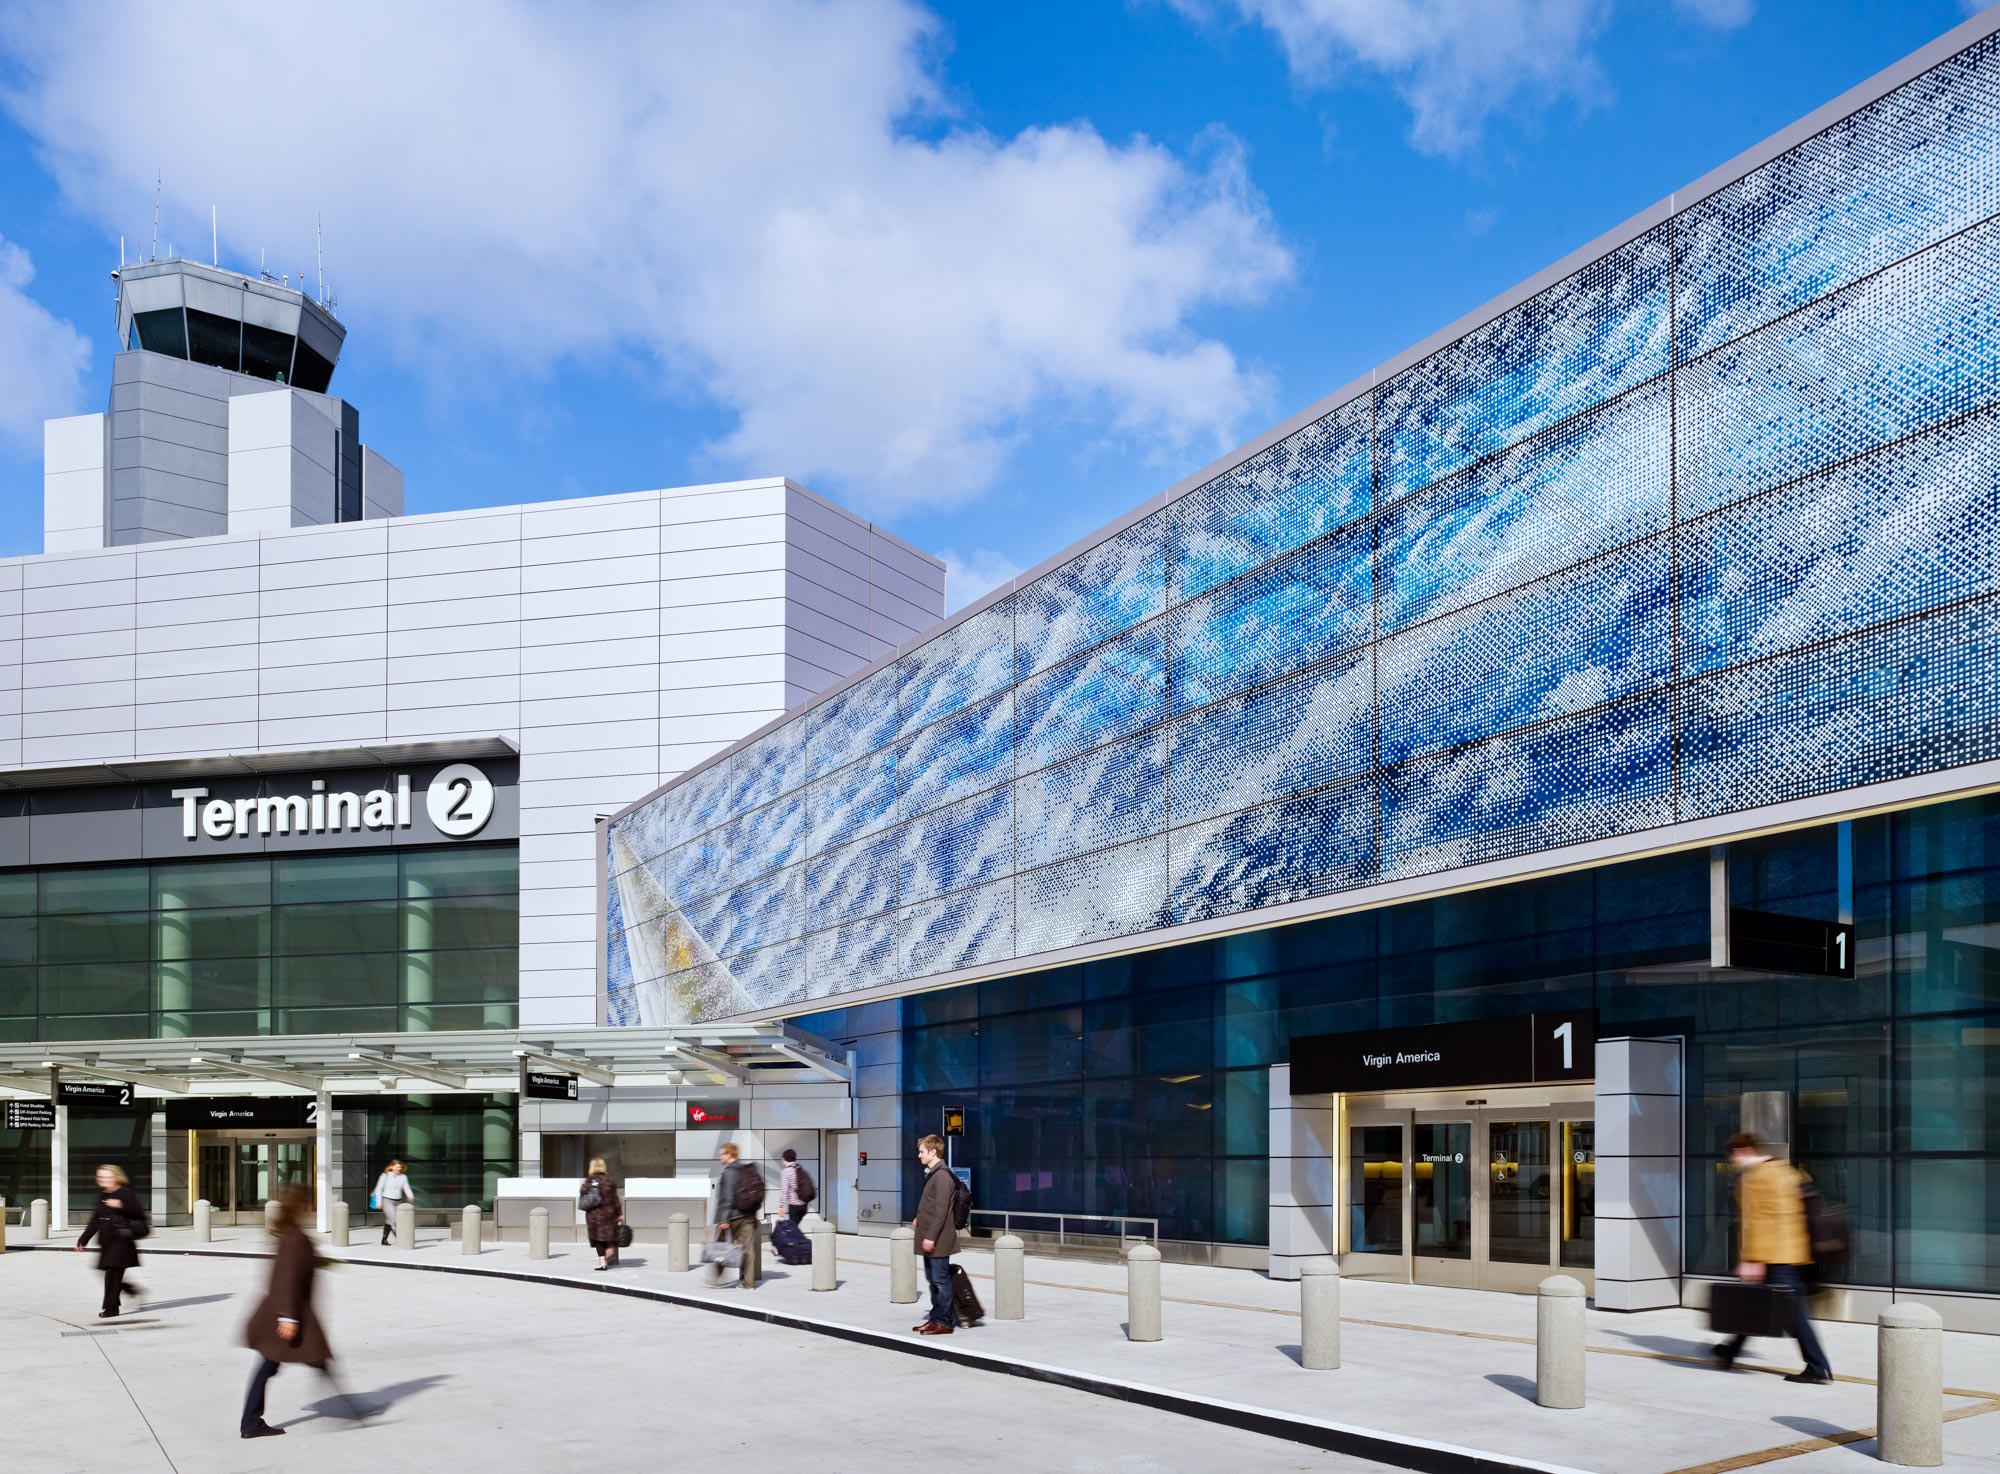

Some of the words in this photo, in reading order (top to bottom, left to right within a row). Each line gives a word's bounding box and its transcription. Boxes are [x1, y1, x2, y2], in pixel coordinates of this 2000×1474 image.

[172, 774, 411, 839] Terminal
[1835, 931, 1846, 970] 1
[1553, 1021, 1573, 1069] 1
[1362, 1054, 1392, 1068] Virgin
[1395, 1050, 1441, 1065] America
[65, 1085, 81, 1093] Virgin
[119, 1088, 130, 1105] 2
[210, 1110, 228, 1119] Virgin
[228, 1110, 254, 1118] America
[306, 1101, 318, 1124] 2
[1422, 1153, 1453, 1163] Terminal
